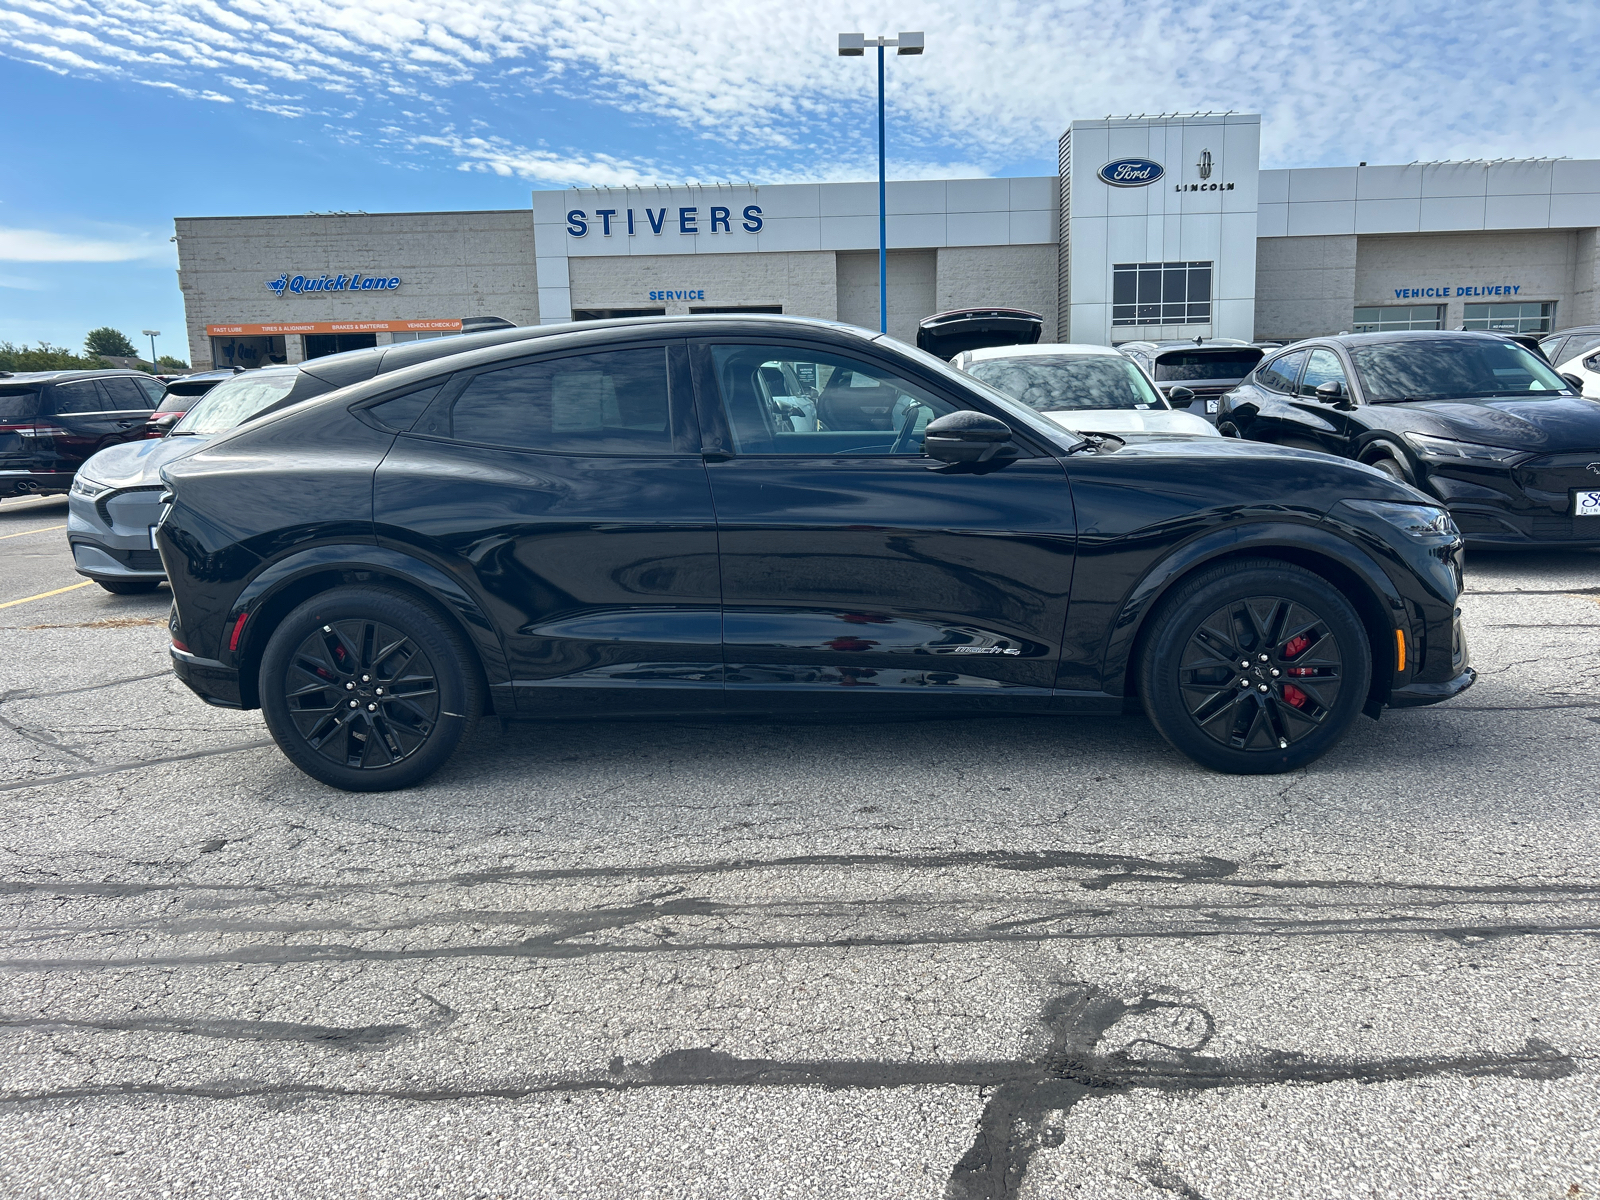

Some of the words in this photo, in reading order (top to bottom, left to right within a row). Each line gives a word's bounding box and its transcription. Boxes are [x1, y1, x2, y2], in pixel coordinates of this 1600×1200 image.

[1114, 163, 1151, 180] Ford
[1176, 183, 1235, 192] LINCOLN
[566, 205, 764, 238] STIVERS
[288, 273, 347, 294] Quick
[348, 273, 400, 291] Lane
[649, 290, 704, 300] SERVICE
[1395, 287, 1450, 298] VEHICLE
[1457, 285, 1520, 297] DELIVERY
